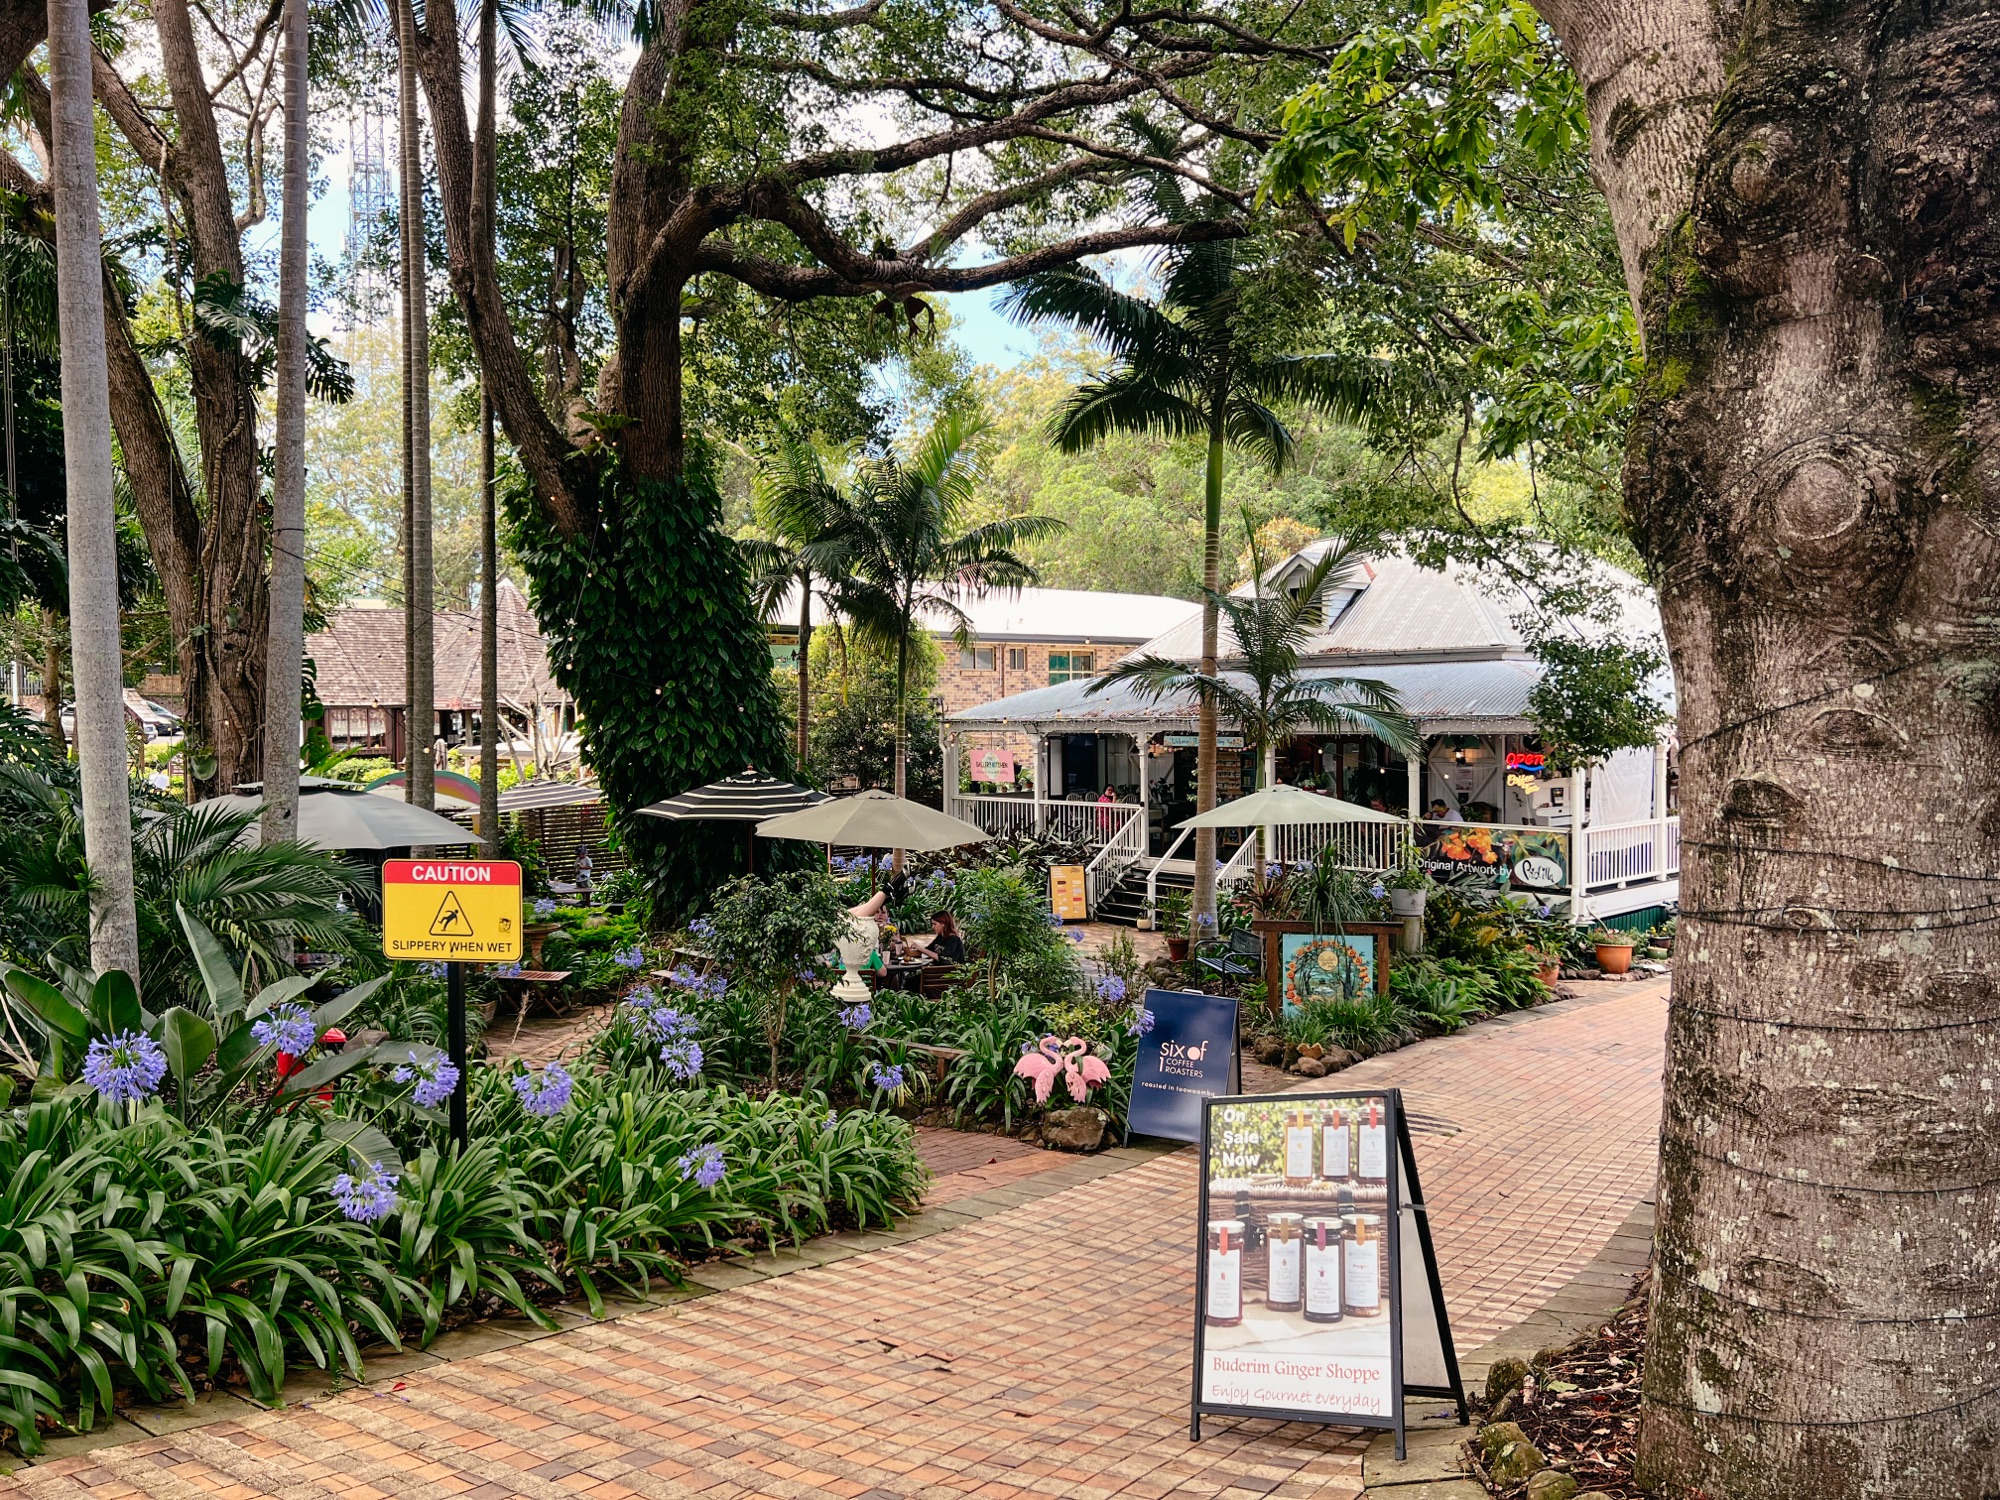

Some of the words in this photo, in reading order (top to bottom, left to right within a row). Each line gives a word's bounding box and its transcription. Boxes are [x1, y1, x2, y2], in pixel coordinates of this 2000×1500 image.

[1507, 774, 1535, 788] Coffee
[1524, 782, 1540, 794] Tea
[412, 865, 491, 882] CAUTION
[1416, 858, 1454, 872] Original
[1456, 861, 1497, 875] Artwork
[1499, 866, 1513, 878] by
[392, 940, 446, 951] SLIPPERY
[450, 942, 484, 952] WHEN
[487, 943, 512, 953] WET
[1160, 1040, 1186, 1059] six
[1187, 1041, 1209, 1061] of
[1166, 1058, 1195, 1069] COFFEE
[1165, 1066, 1204, 1078] ROASTERS
[1141, 1082, 1167, 1090] roasted
[1223, 1108, 1246, 1122] On
[1223, 1131, 1259, 1144] Sale
[1223, 1153, 1260, 1167] Now
[1213, 1357, 1270, 1374] Buderim
[1275, 1360, 1322, 1380] Ginger
[1326, 1363, 1380, 1384] Shoppe
[1212, 1382, 1250, 1405] Enjoy
[1254, 1388, 1311, 1403] Gourmet
[1316, 1393, 1381, 1415] everyday
